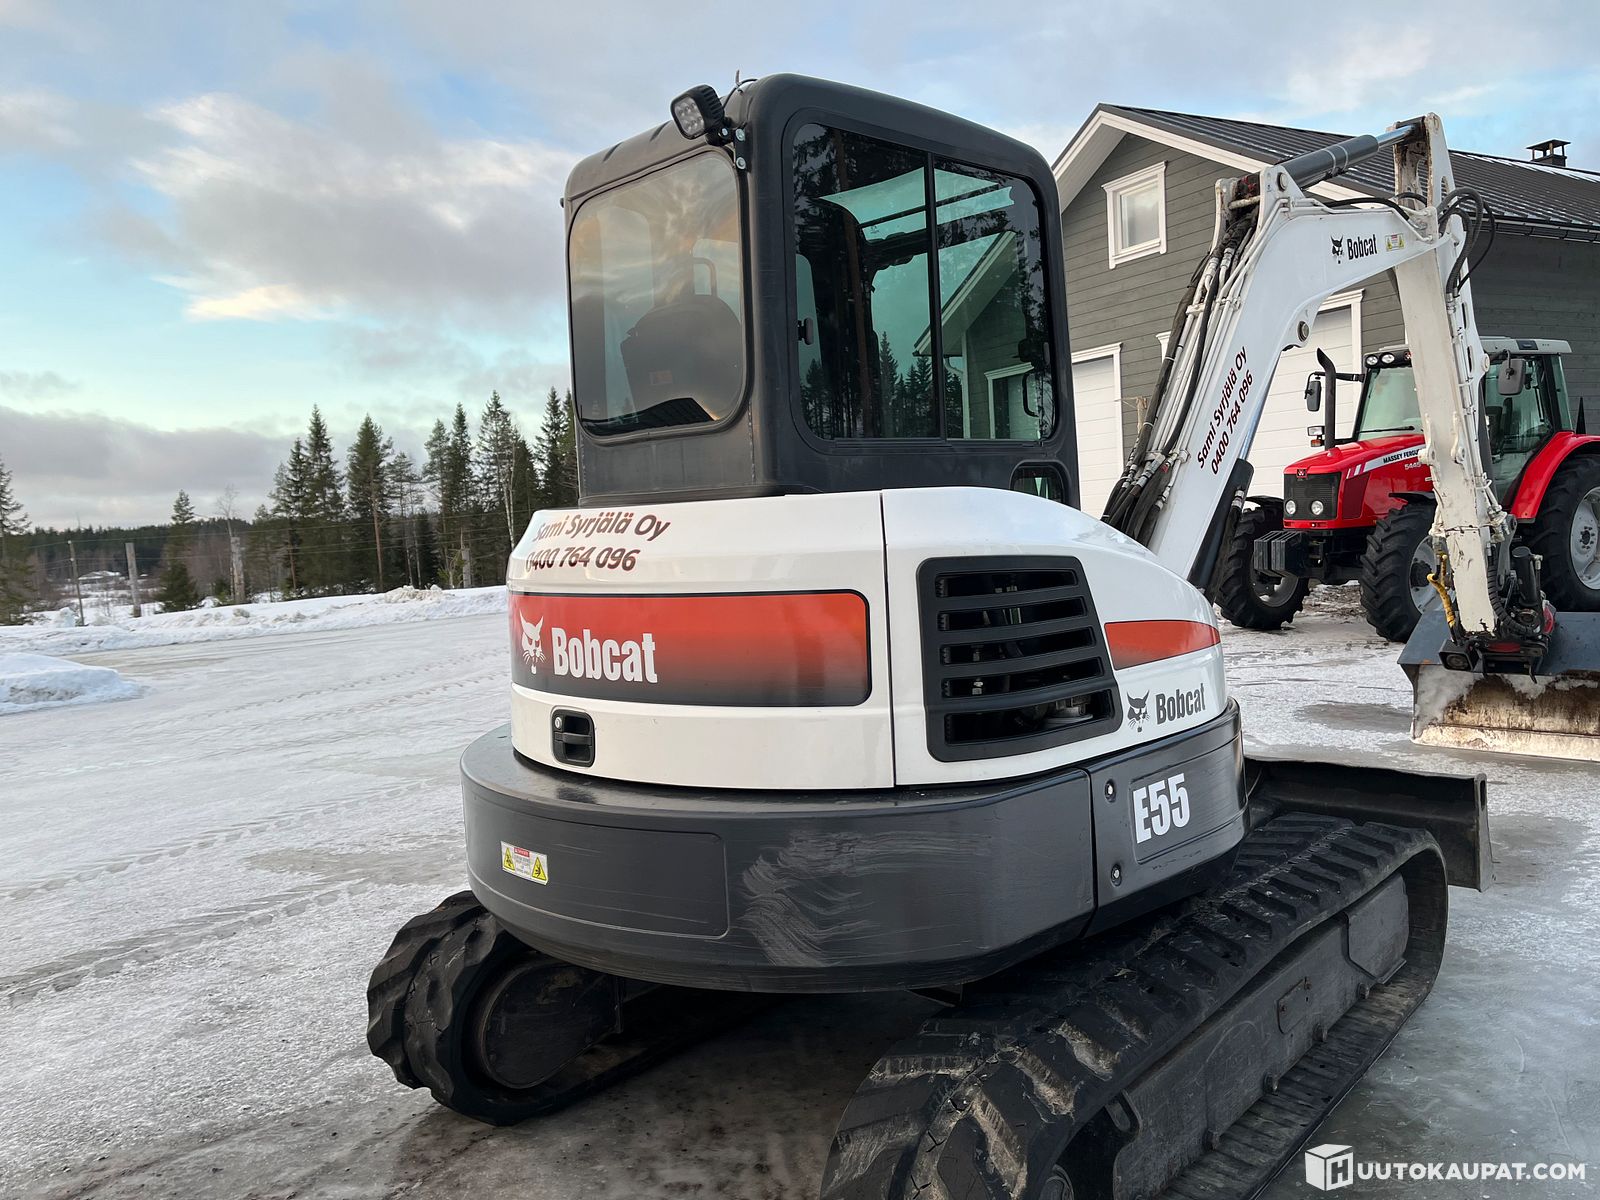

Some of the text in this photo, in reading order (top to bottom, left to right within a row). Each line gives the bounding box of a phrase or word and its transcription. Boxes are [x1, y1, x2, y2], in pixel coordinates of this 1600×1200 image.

[1347, 234, 1377, 260] Bobcat
[1197, 346, 1247, 469] Sami Syrjälä Oy
[1211, 369, 1253, 475] 0400 764 096
[1383, 449, 1419, 464] MASSEY FERGU
[532, 512, 671, 542] Sami Syrjälä Oy
[526, 546, 641, 572] 0400 764 096
[551, 627, 658, 683] Bobcat
[1155, 683, 1206, 725] Bobcat
[1133, 773, 1190, 844] E55
